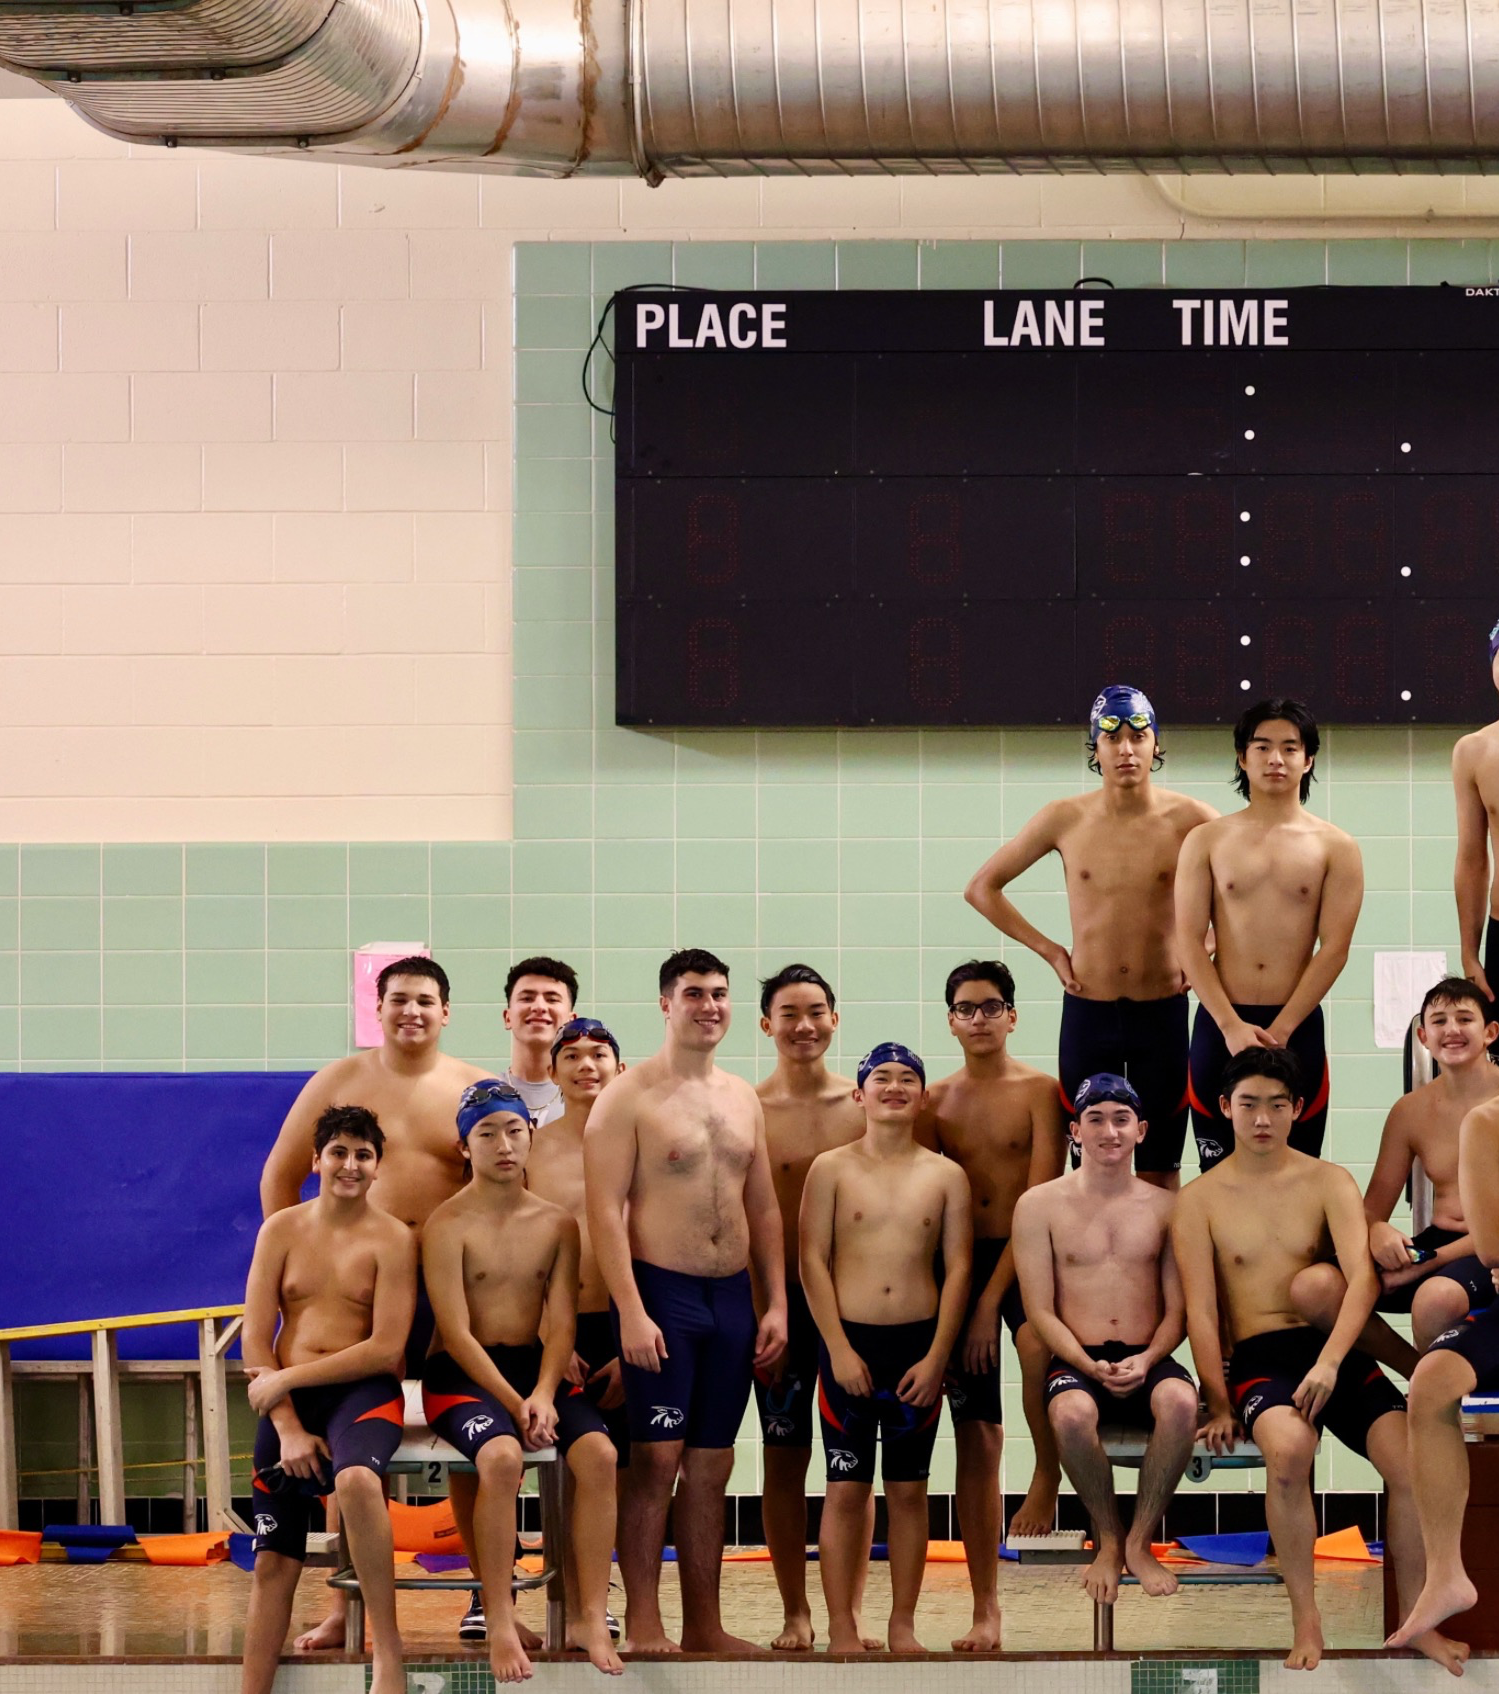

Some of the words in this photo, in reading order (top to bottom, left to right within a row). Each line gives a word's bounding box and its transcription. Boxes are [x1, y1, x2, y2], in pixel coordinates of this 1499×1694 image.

[636, 303, 787, 348] PLACE
[983, 300, 1105, 347] LANE
[1172, 299, 1289, 346] TIME
[428, 1461, 442, 1483] 2
[1192, 1456, 1203, 1478] 3
